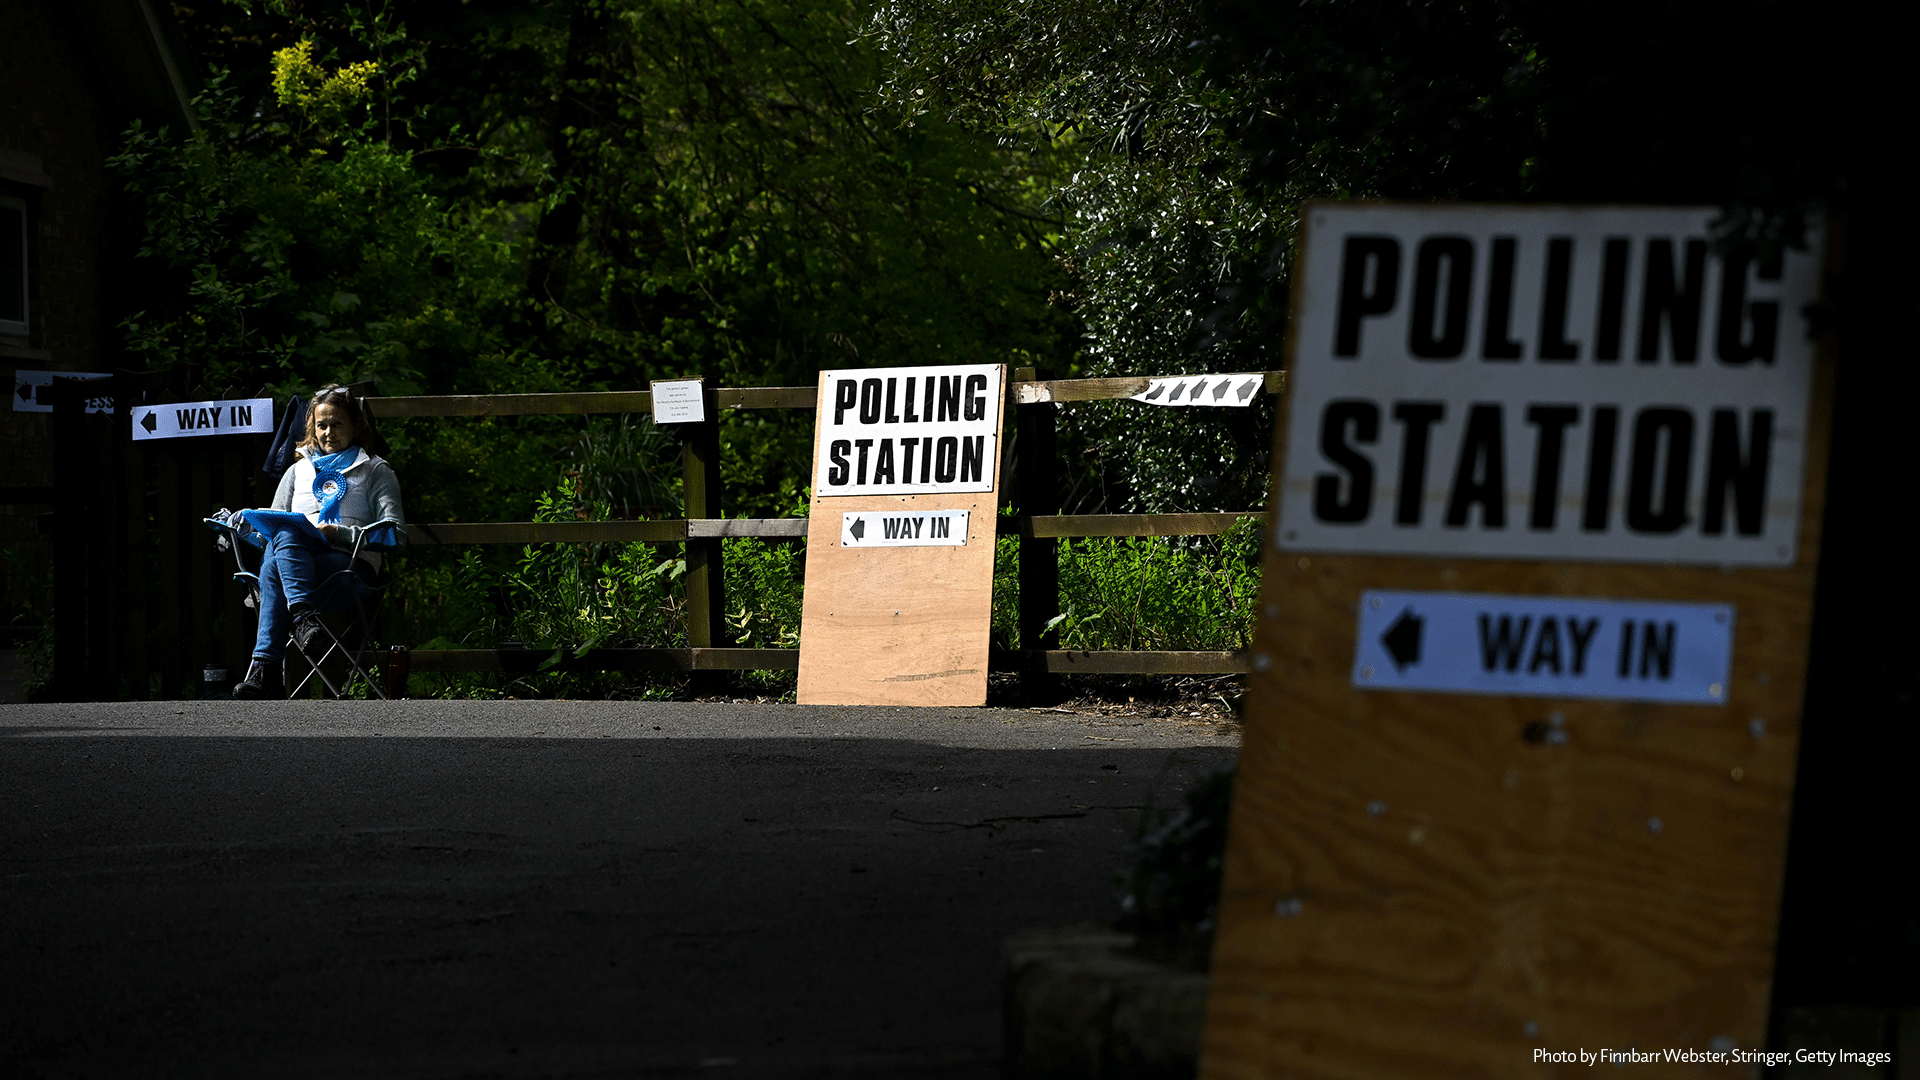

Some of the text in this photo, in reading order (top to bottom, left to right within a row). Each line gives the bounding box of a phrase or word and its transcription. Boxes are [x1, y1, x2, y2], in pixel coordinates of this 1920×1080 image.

[1335, 235, 1784, 364] POLLING
[177, 406, 252, 430] WAY IN
[834, 374, 987, 425] POLLING
[829, 436, 985, 486] STATION
[1315, 401, 1772, 537] STATION
[883, 517, 950, 540] WAY IN
[1478, 612, 1677, 682] WAY IN
